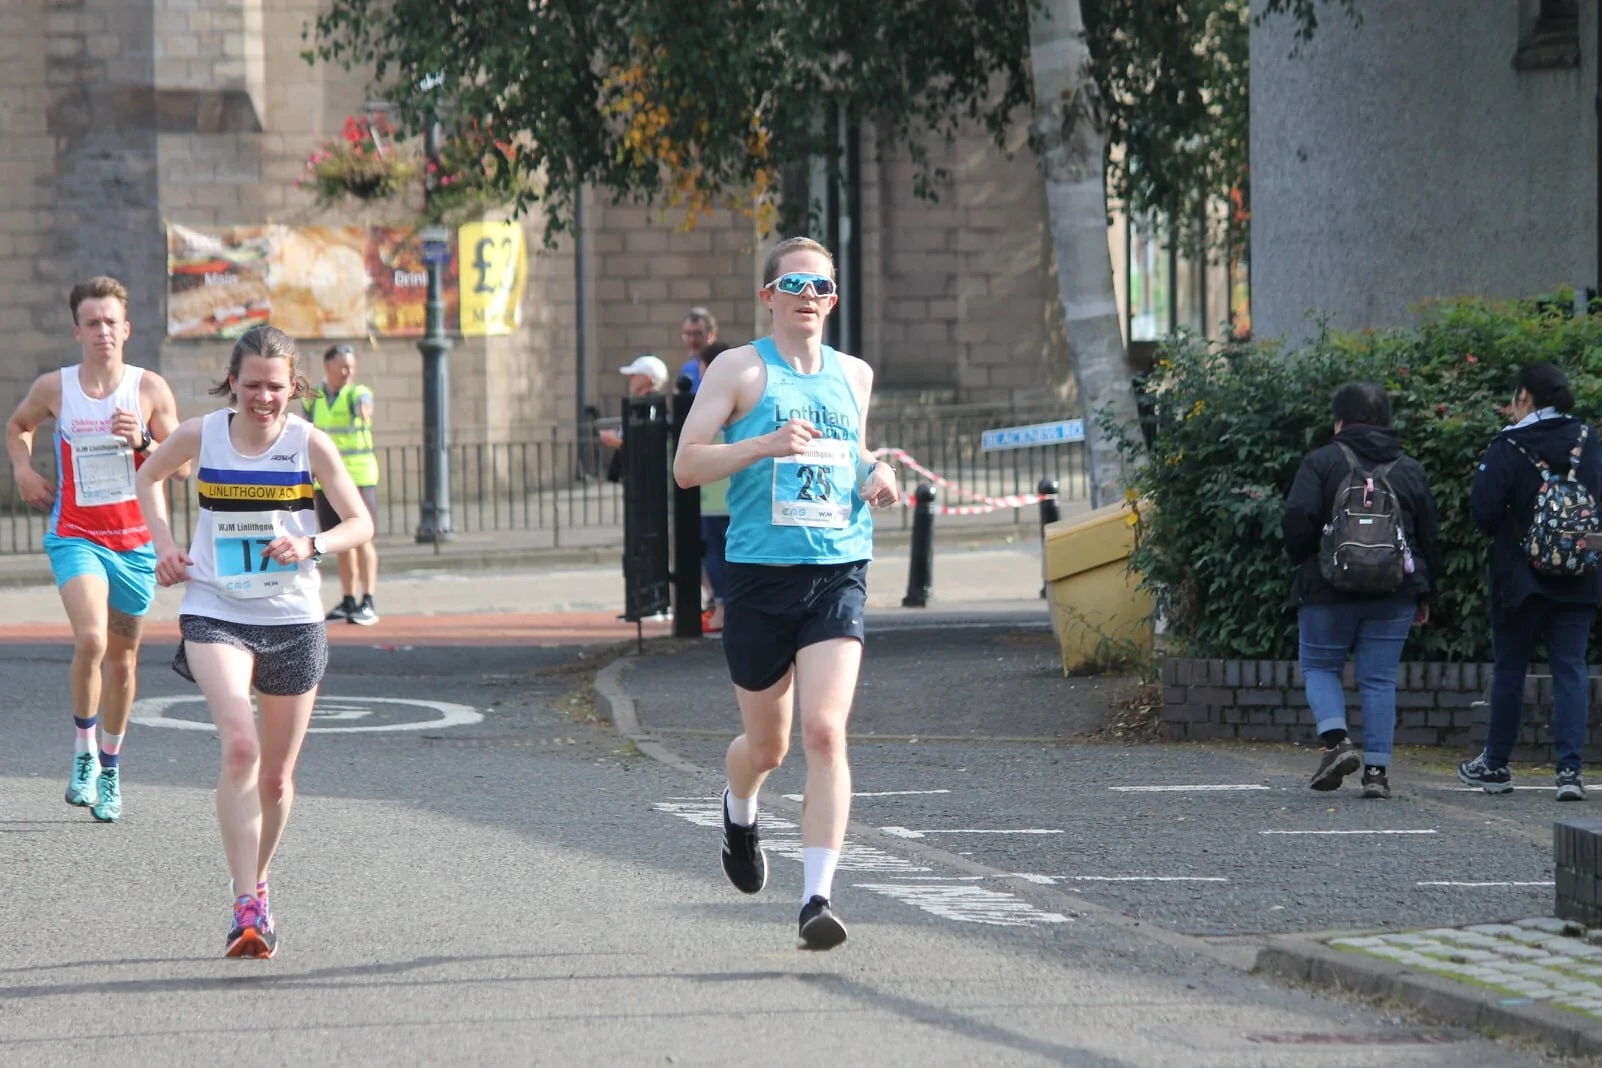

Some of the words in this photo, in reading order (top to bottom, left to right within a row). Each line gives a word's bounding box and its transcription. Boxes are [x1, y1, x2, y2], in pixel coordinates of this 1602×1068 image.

[776, 404, 850, 428] Lothian
[209, 486, 276, 498] LINLITHGOW
[797, 465, 831, 501] 25
[218, 523, 235, 532] WJM
[237, 523, 274, 533] Linlithgow
[242, 540, 273, 572] 17
